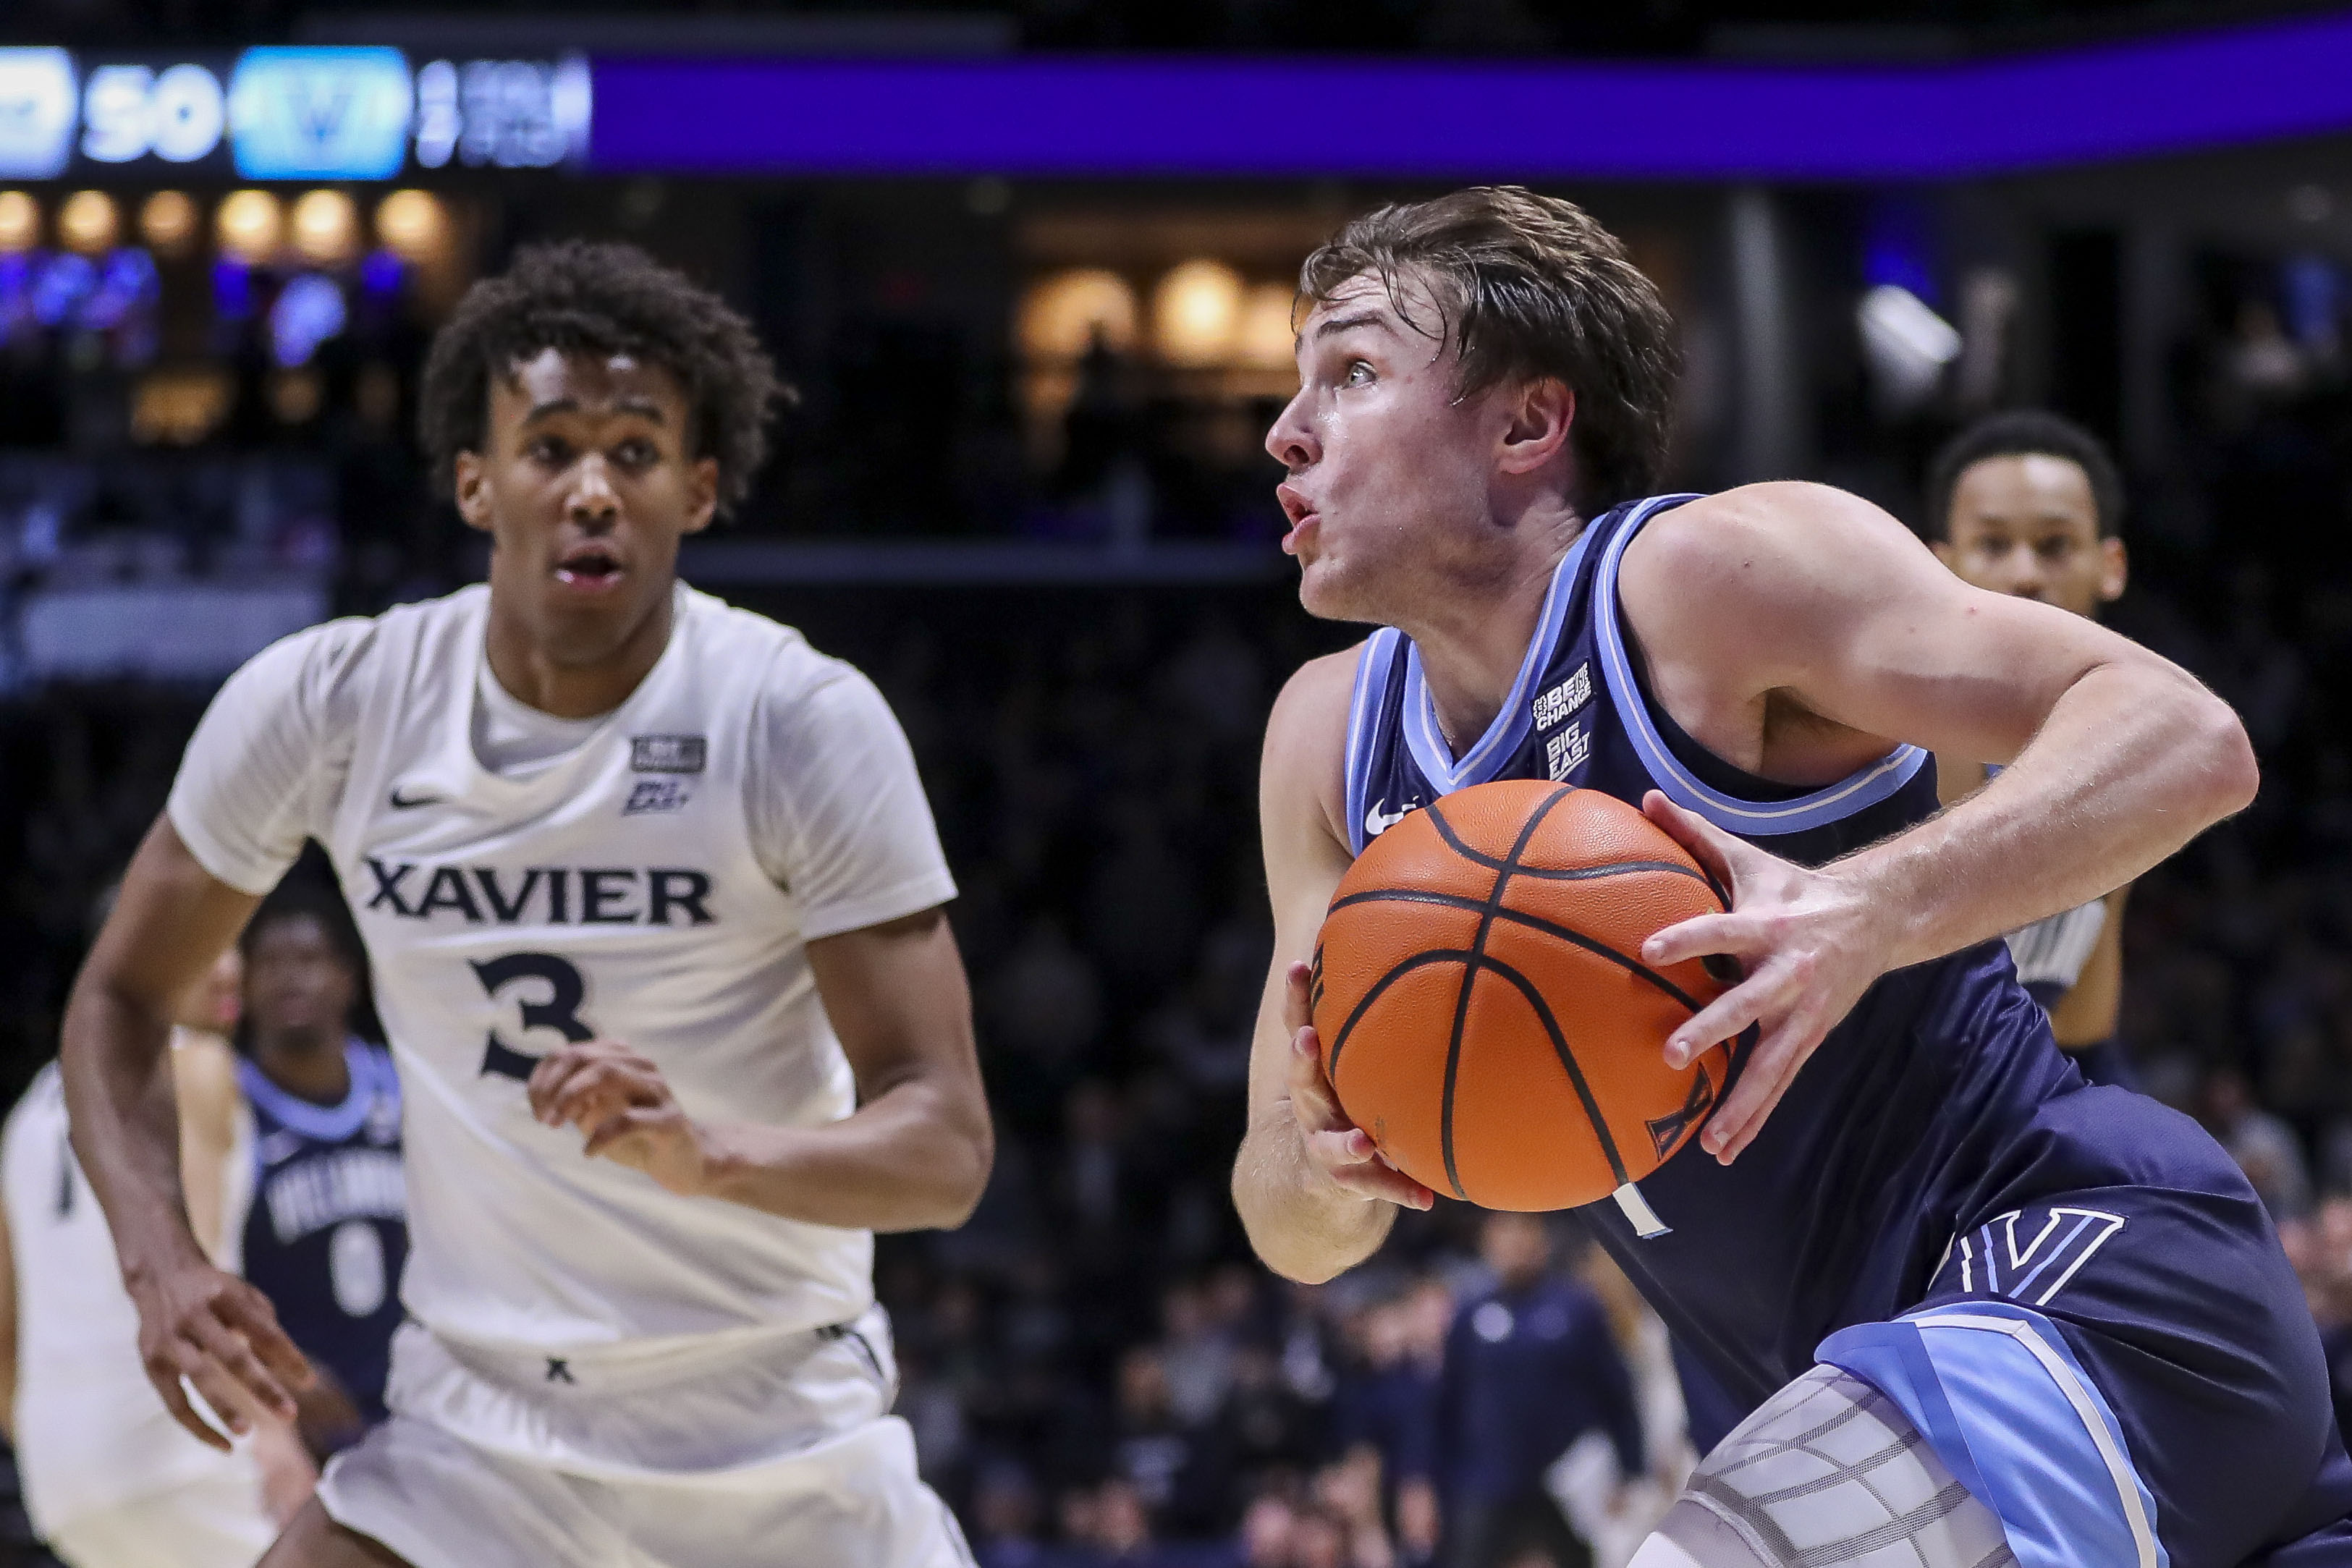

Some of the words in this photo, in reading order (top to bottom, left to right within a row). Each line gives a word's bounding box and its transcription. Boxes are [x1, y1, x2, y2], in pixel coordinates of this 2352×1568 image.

[83, 64, 224, 163] 50
[1536, 681, 1591, 732] CHANGE
[1546, 721, 1580, 762] BIG
[1549, 732, 1590, 781] EAST
[365, 857, 718, 926] XAVIER
[467, 952, 595, 1081] 3
[329, 1219, 386, 1316] 0
